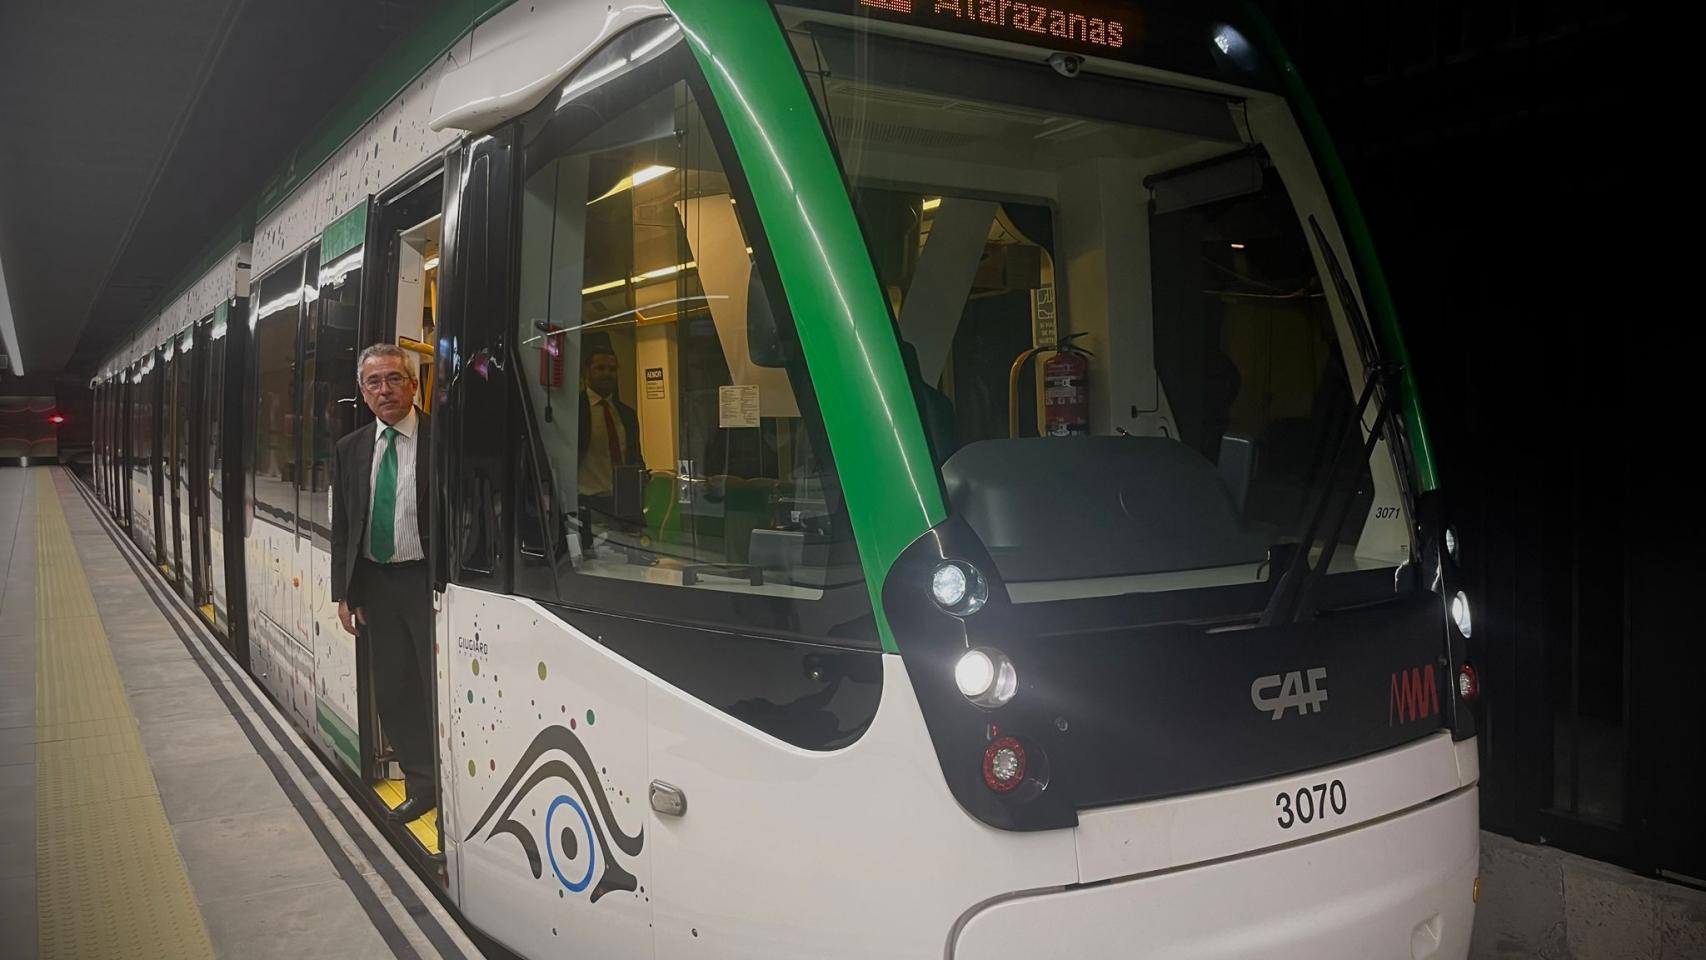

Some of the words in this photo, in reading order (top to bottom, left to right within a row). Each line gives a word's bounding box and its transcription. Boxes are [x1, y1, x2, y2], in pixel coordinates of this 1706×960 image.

[1375, 506, 1401, 519] 3071
[1251, 667, 1328, 720] CAF
[1275, 779, 1347, 829] 3070
